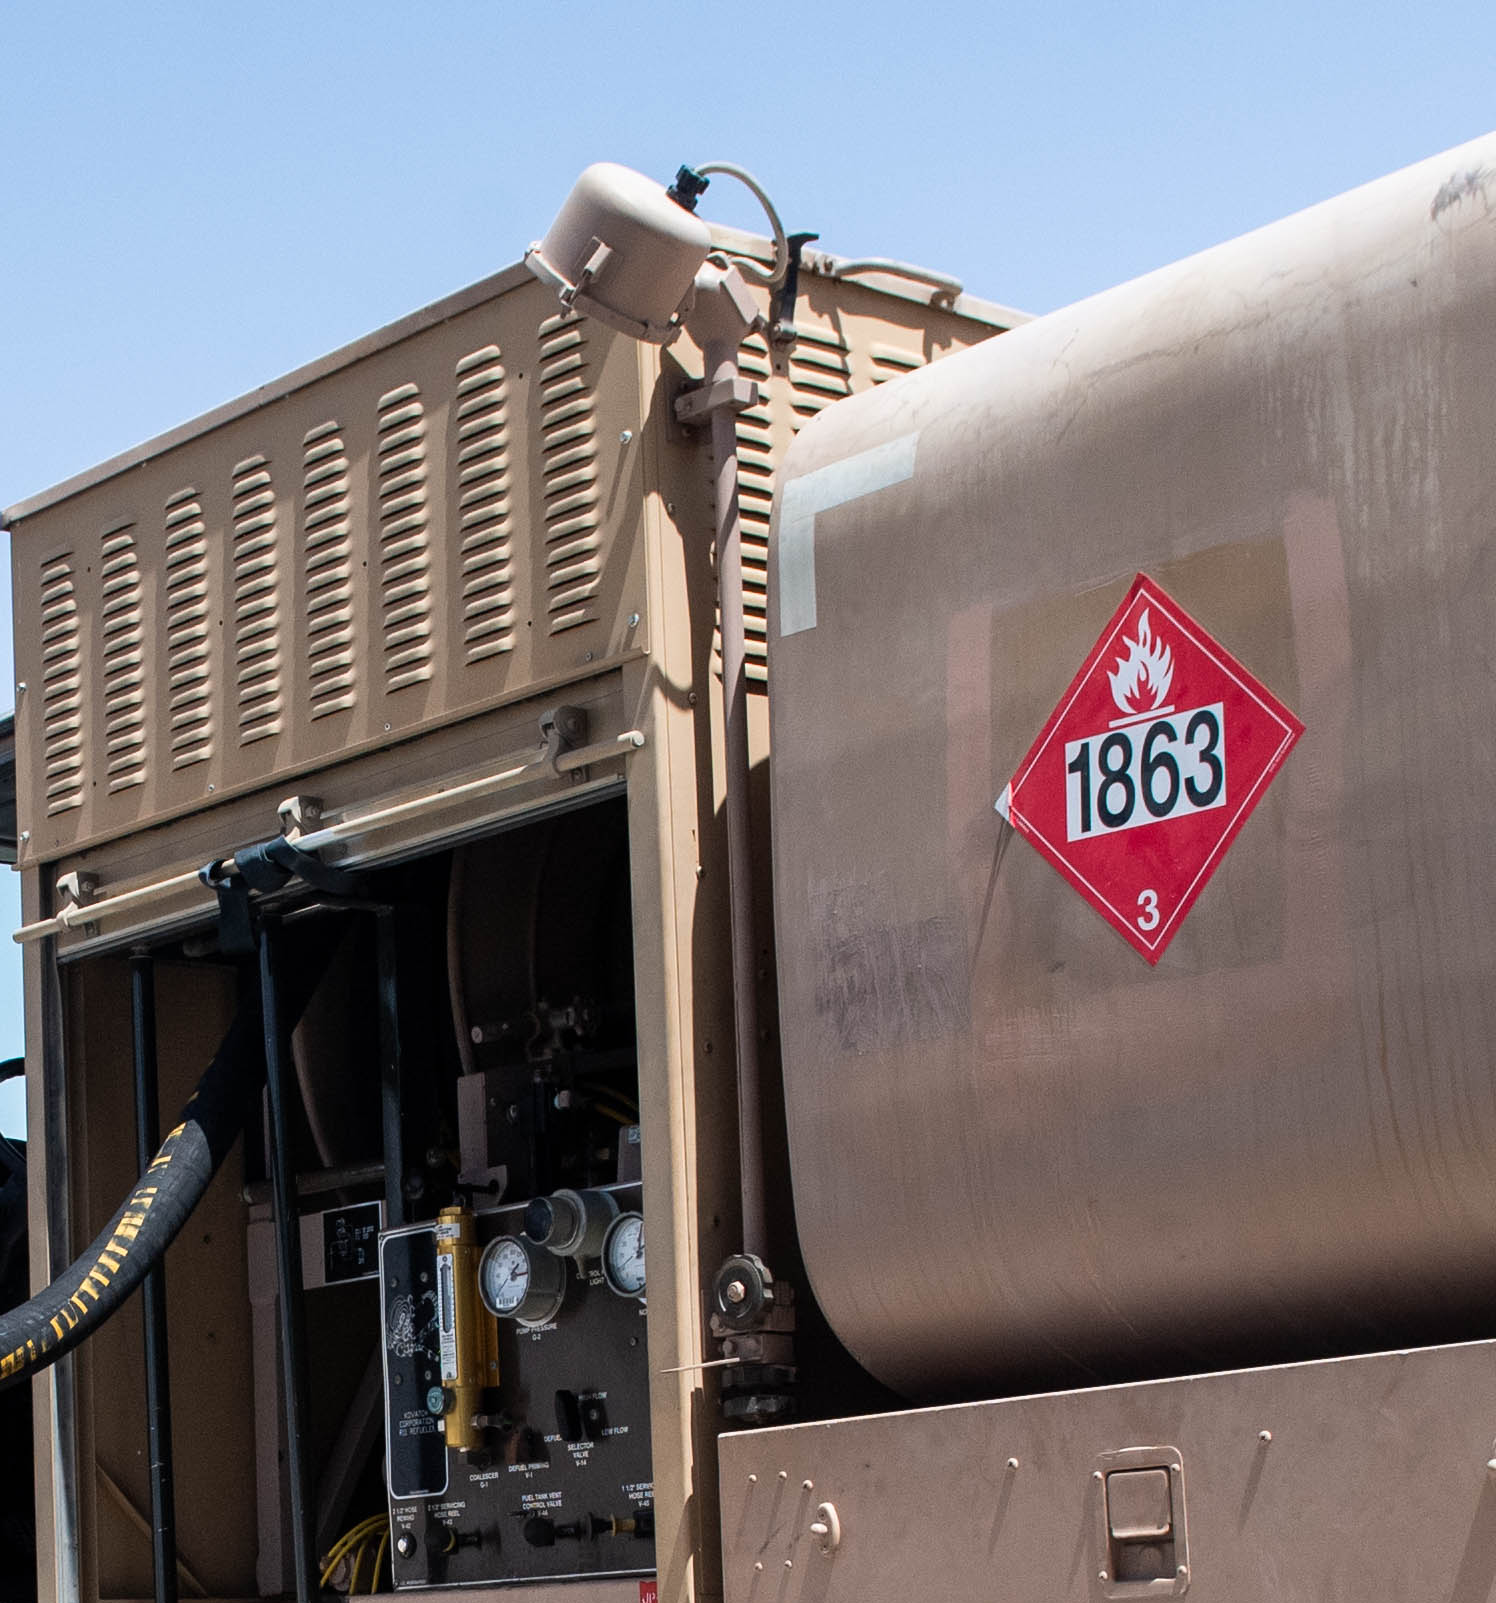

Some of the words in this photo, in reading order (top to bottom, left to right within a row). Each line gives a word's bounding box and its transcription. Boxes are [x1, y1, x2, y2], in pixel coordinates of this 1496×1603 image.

[1067, 709, 1224, 835] 1863
[1136, 888, 1161, 932] 3
[614, 1426, 629, 1435] FLOW
[567, 1442, 594, 1451] SELECTOR
[573, 1450, 589, 1459] VALVE
[508, 1464, 527, 1472] DEFUEL
[469, 1472, 499, 1482] COALESCER
[522, 1494, 535, 1502] FUEL
[535, 1493, 548, 1501] TANK
[549, 1491, 562, 1500] VENT
[522, 1501, 546, 1510] CONTROL
[547, 1499, 562, 1508] VALVE
